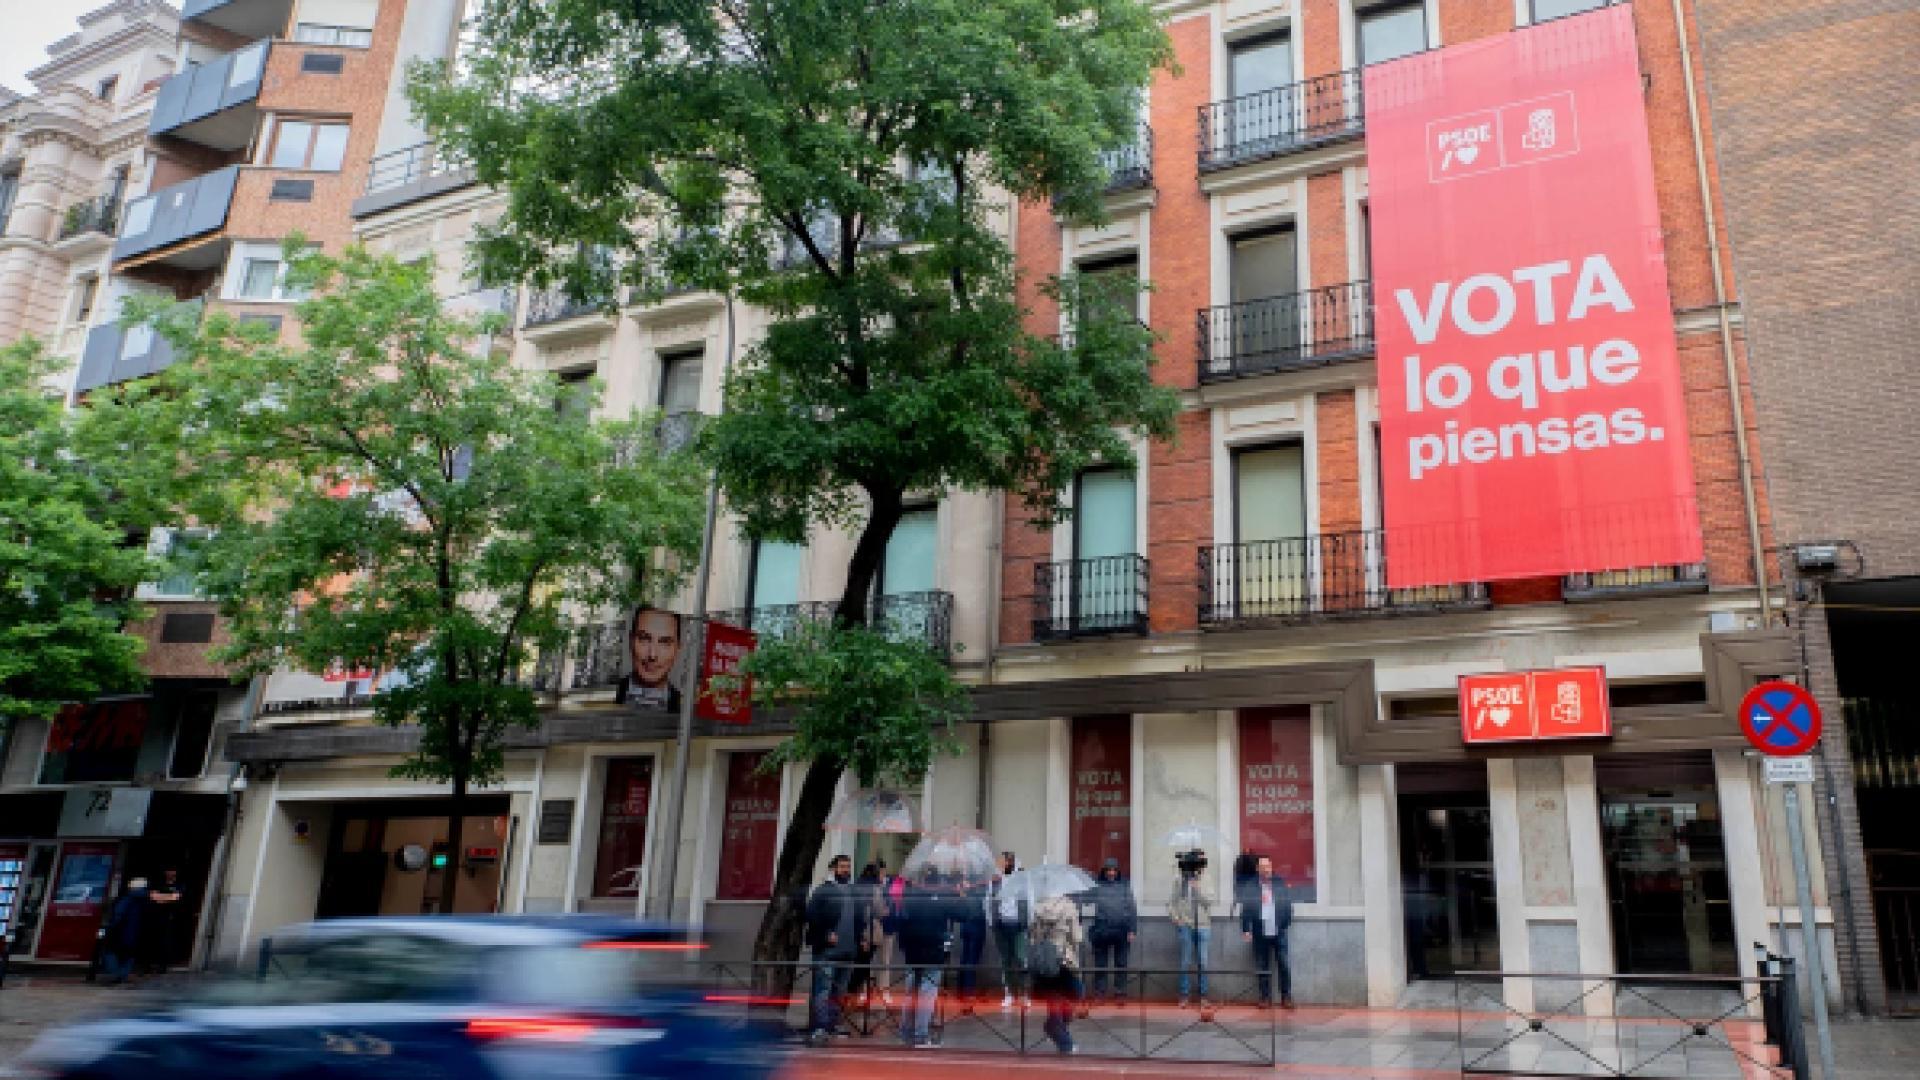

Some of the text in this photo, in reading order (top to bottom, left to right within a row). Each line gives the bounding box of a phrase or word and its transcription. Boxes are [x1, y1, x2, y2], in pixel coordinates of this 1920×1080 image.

[1438, 124, 1492, 150] PSOE
[1395, 253, 1635, 345] VOTA
[1404, 337, 1641, 412] lo que
[1409, 406, 1664, 480] piensas.
[1470, 684, 1523, 707] PSOE
[1077, 770, 1121, 785] VOTA
[1246, 763, 1298, 779] VOTA
